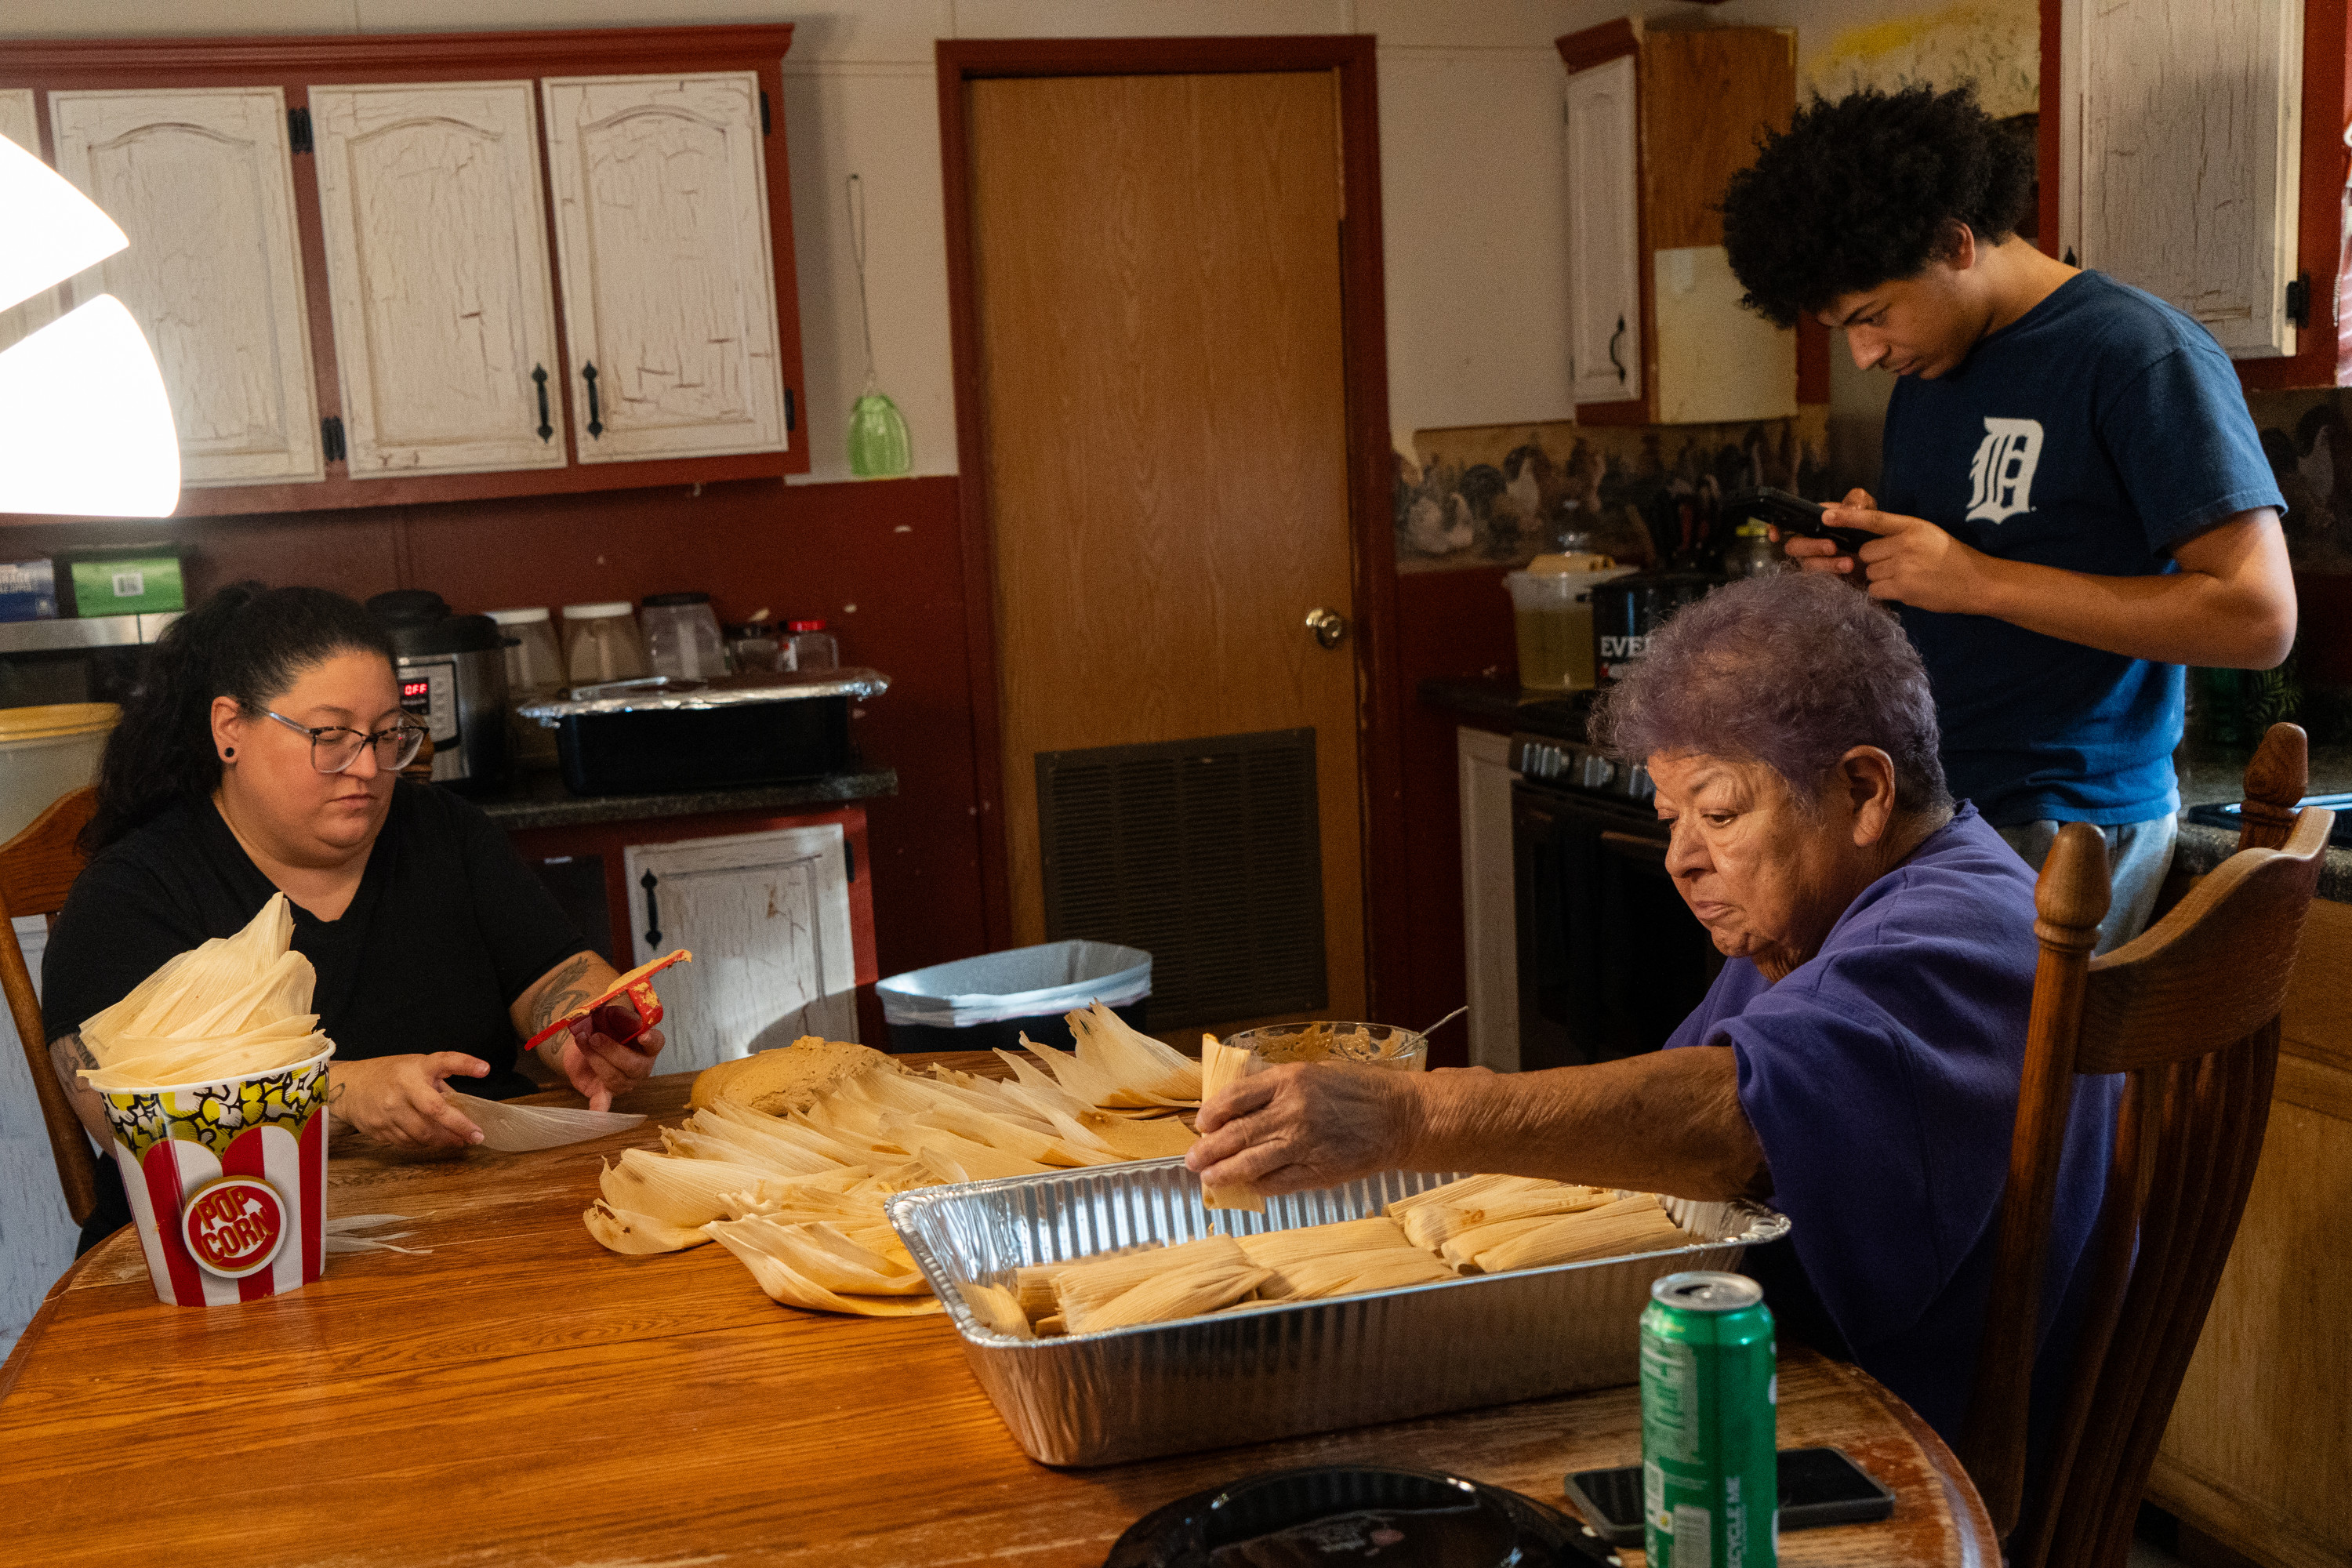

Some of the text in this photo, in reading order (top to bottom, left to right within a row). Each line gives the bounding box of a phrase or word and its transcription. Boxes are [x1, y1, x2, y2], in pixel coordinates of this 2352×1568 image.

[1965, 416, 2044, 524] D
[405, 683, 427, 696] OFF
[194, 1187, 249, 1231] POP
[201, 1206, 274, 1263] CORN
